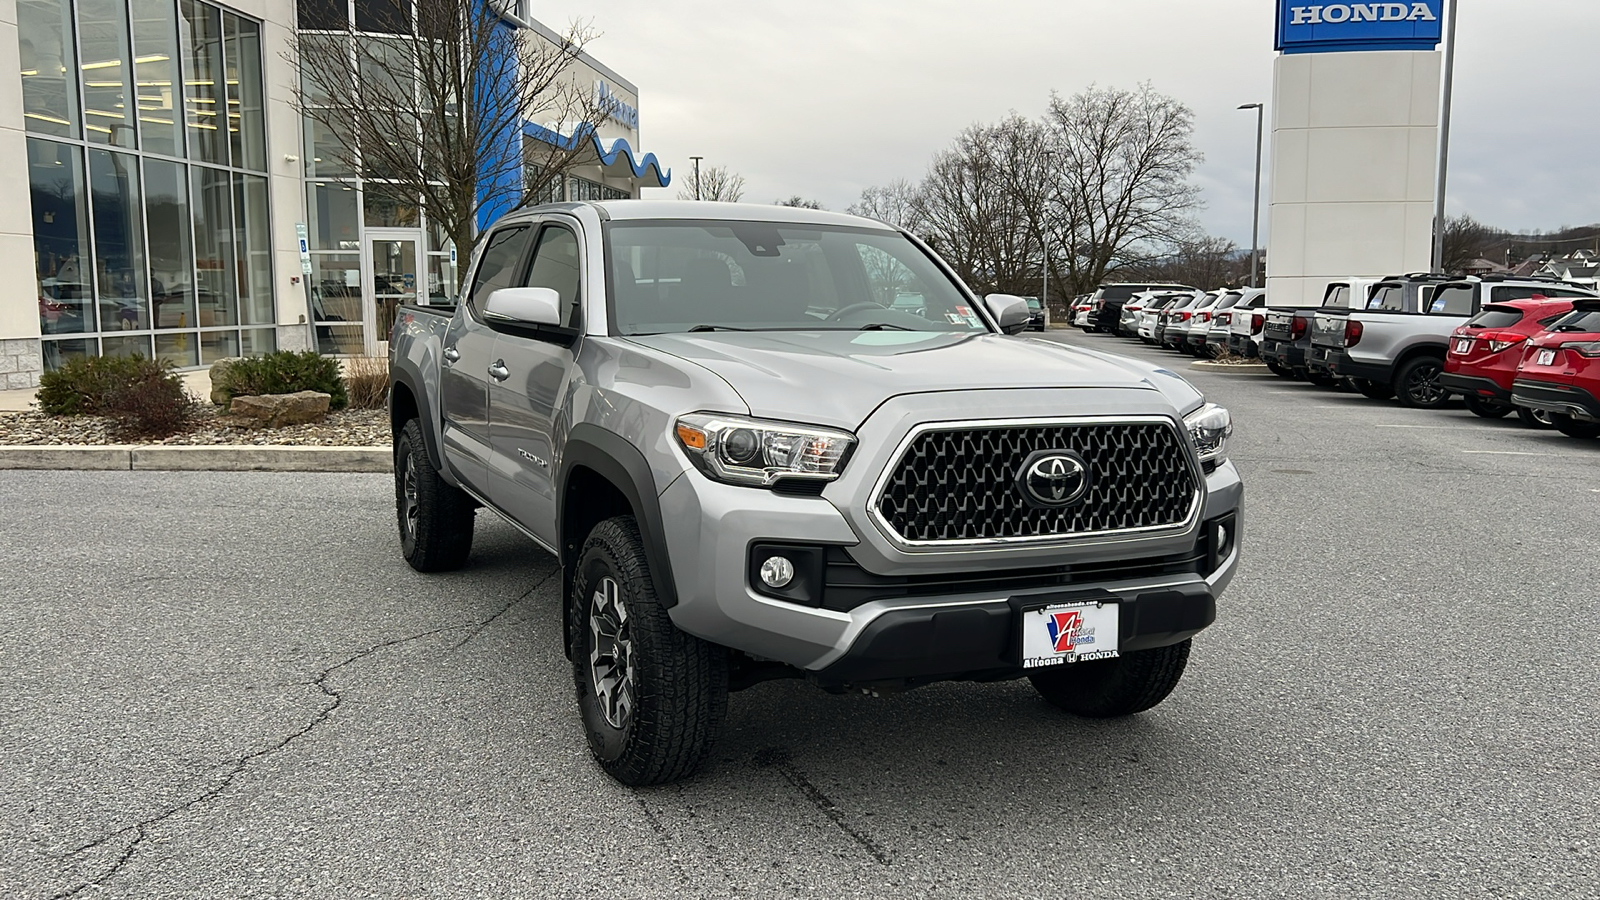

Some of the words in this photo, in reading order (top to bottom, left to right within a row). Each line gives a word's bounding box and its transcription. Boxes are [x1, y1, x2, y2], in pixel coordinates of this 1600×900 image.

[1290, 2, 1437, 25] HONDA
[1046, 600, 1098, 610] altoonahonda.com
[1023, 656, 1064, 668] Altoona
[1080, 651, 1120, 662] HONDA
